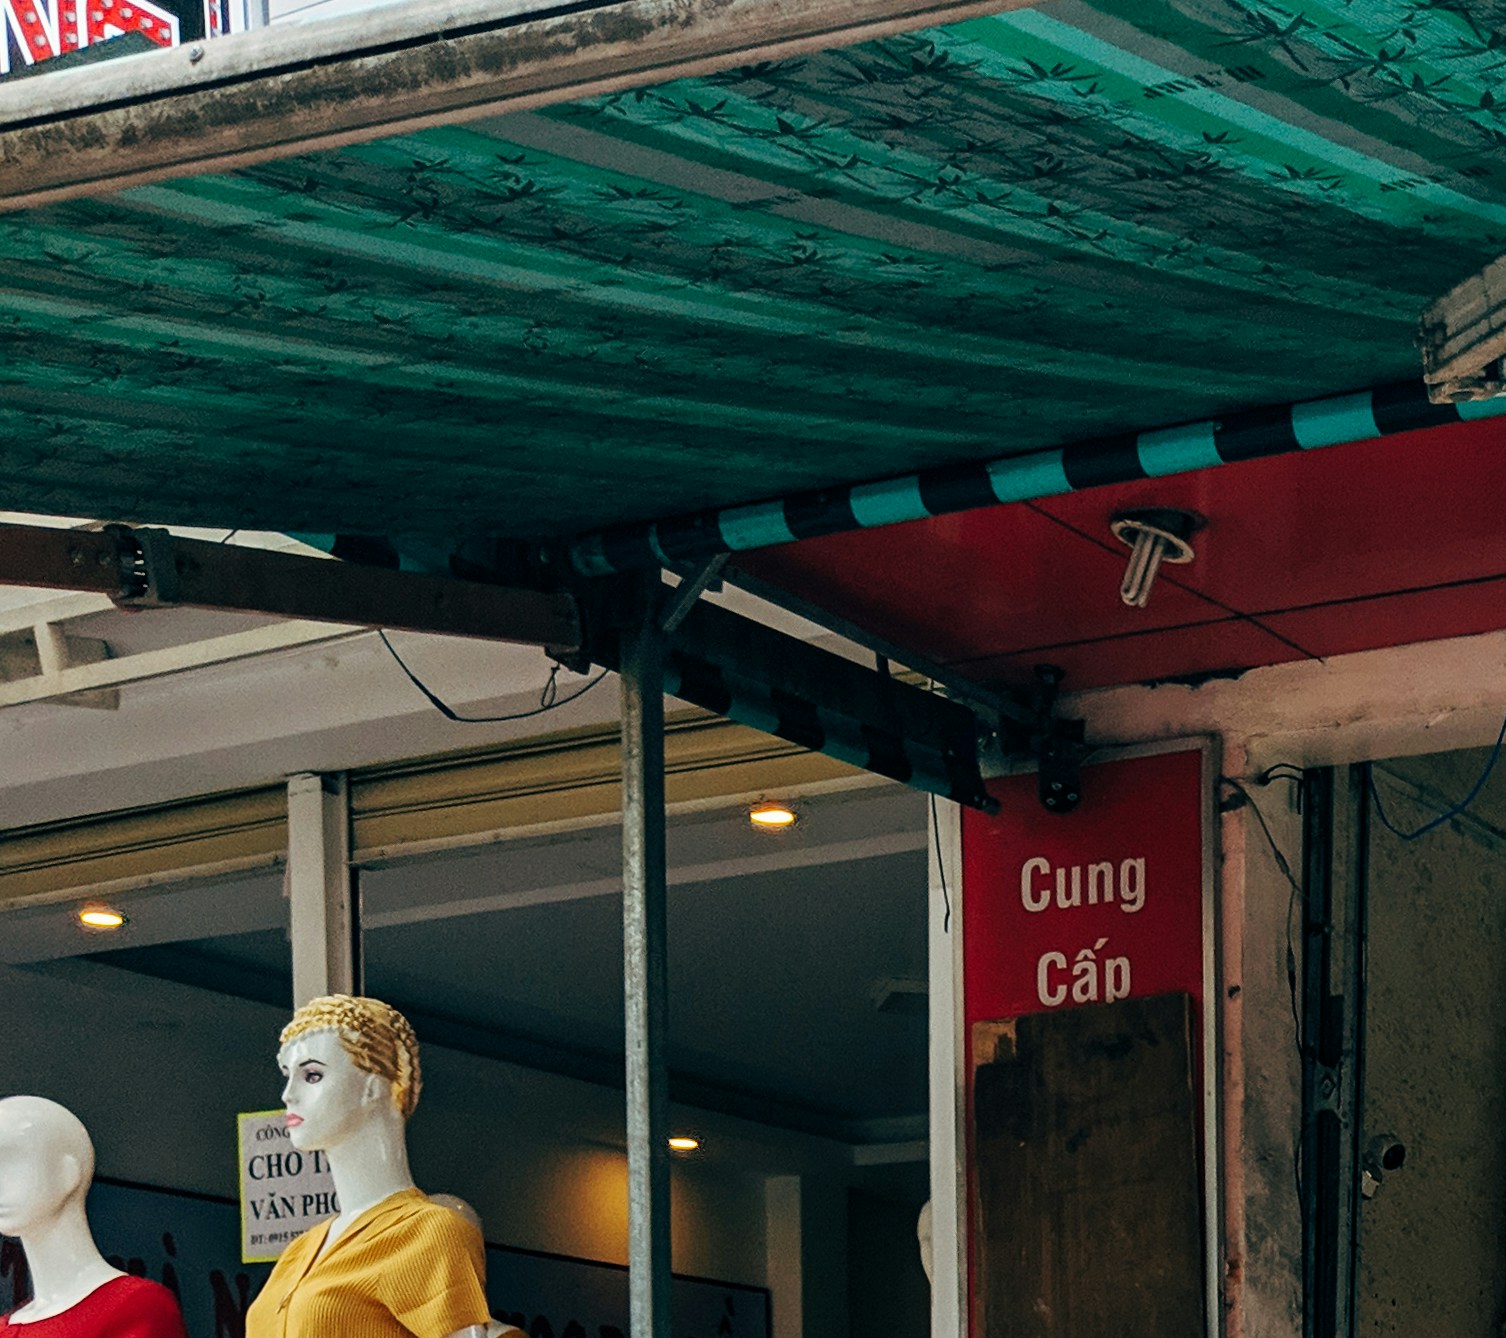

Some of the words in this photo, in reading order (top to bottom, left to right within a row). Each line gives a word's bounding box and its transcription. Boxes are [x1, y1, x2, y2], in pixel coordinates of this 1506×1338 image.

[1021, 857, 1146, 912] Cung
[1037, 938, 1131, 1007] Cấp
[248, 1151, 303, 1180] CHO
[250, 1191, 296, 1220] VĂN
